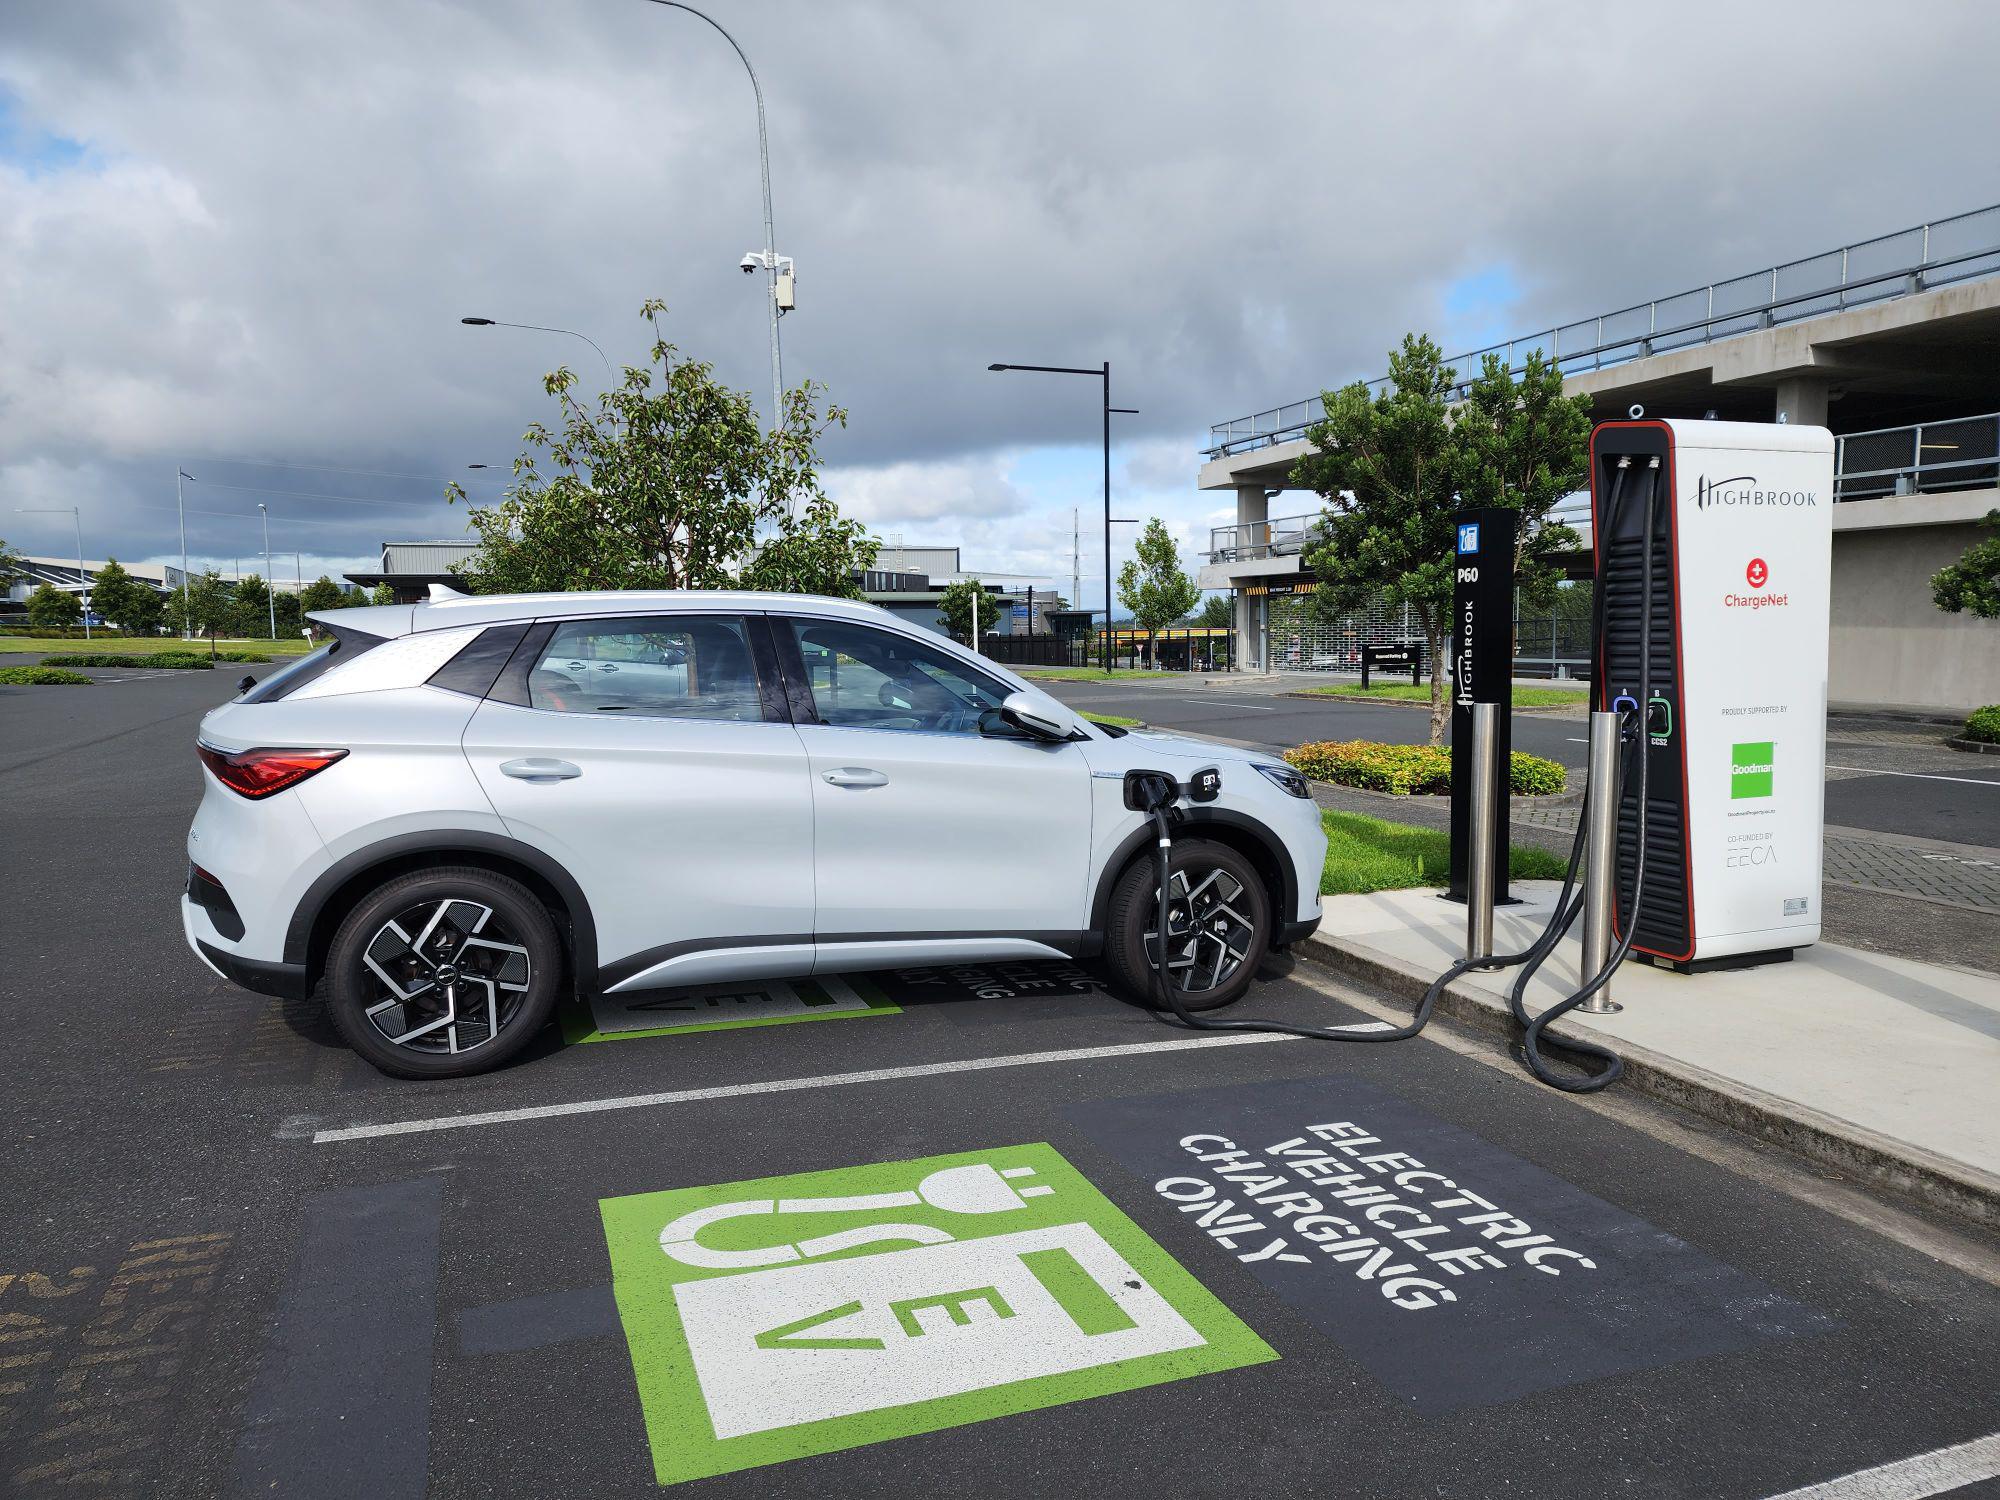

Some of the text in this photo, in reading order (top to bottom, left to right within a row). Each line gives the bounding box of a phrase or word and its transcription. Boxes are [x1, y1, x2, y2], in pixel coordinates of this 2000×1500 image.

[1688, 473, 1816, 511] HIGHBROOK
[1457, 567, 1479, 583] P60
[1724, 593, 1788, 609] ChargeNet
[1456, 600, 1475, 713] HIGHBROOK
[1721, 704, 1788, 716] PROUDLY SUPPORTED BY
[1651, 737, 1668, 746] CCS2
[1732, 763, 1774, 775] Goodman
[1155, 1176, 1312, 1263] ONLY
[1179, 1134, 1457, 1310] CHARGING
[1264, 1137, 1507, 1275] VEHICLE
[1305, 1121, 1597, 1276] ELECTRIC
[754, 1286, 1017, 1350] EV
